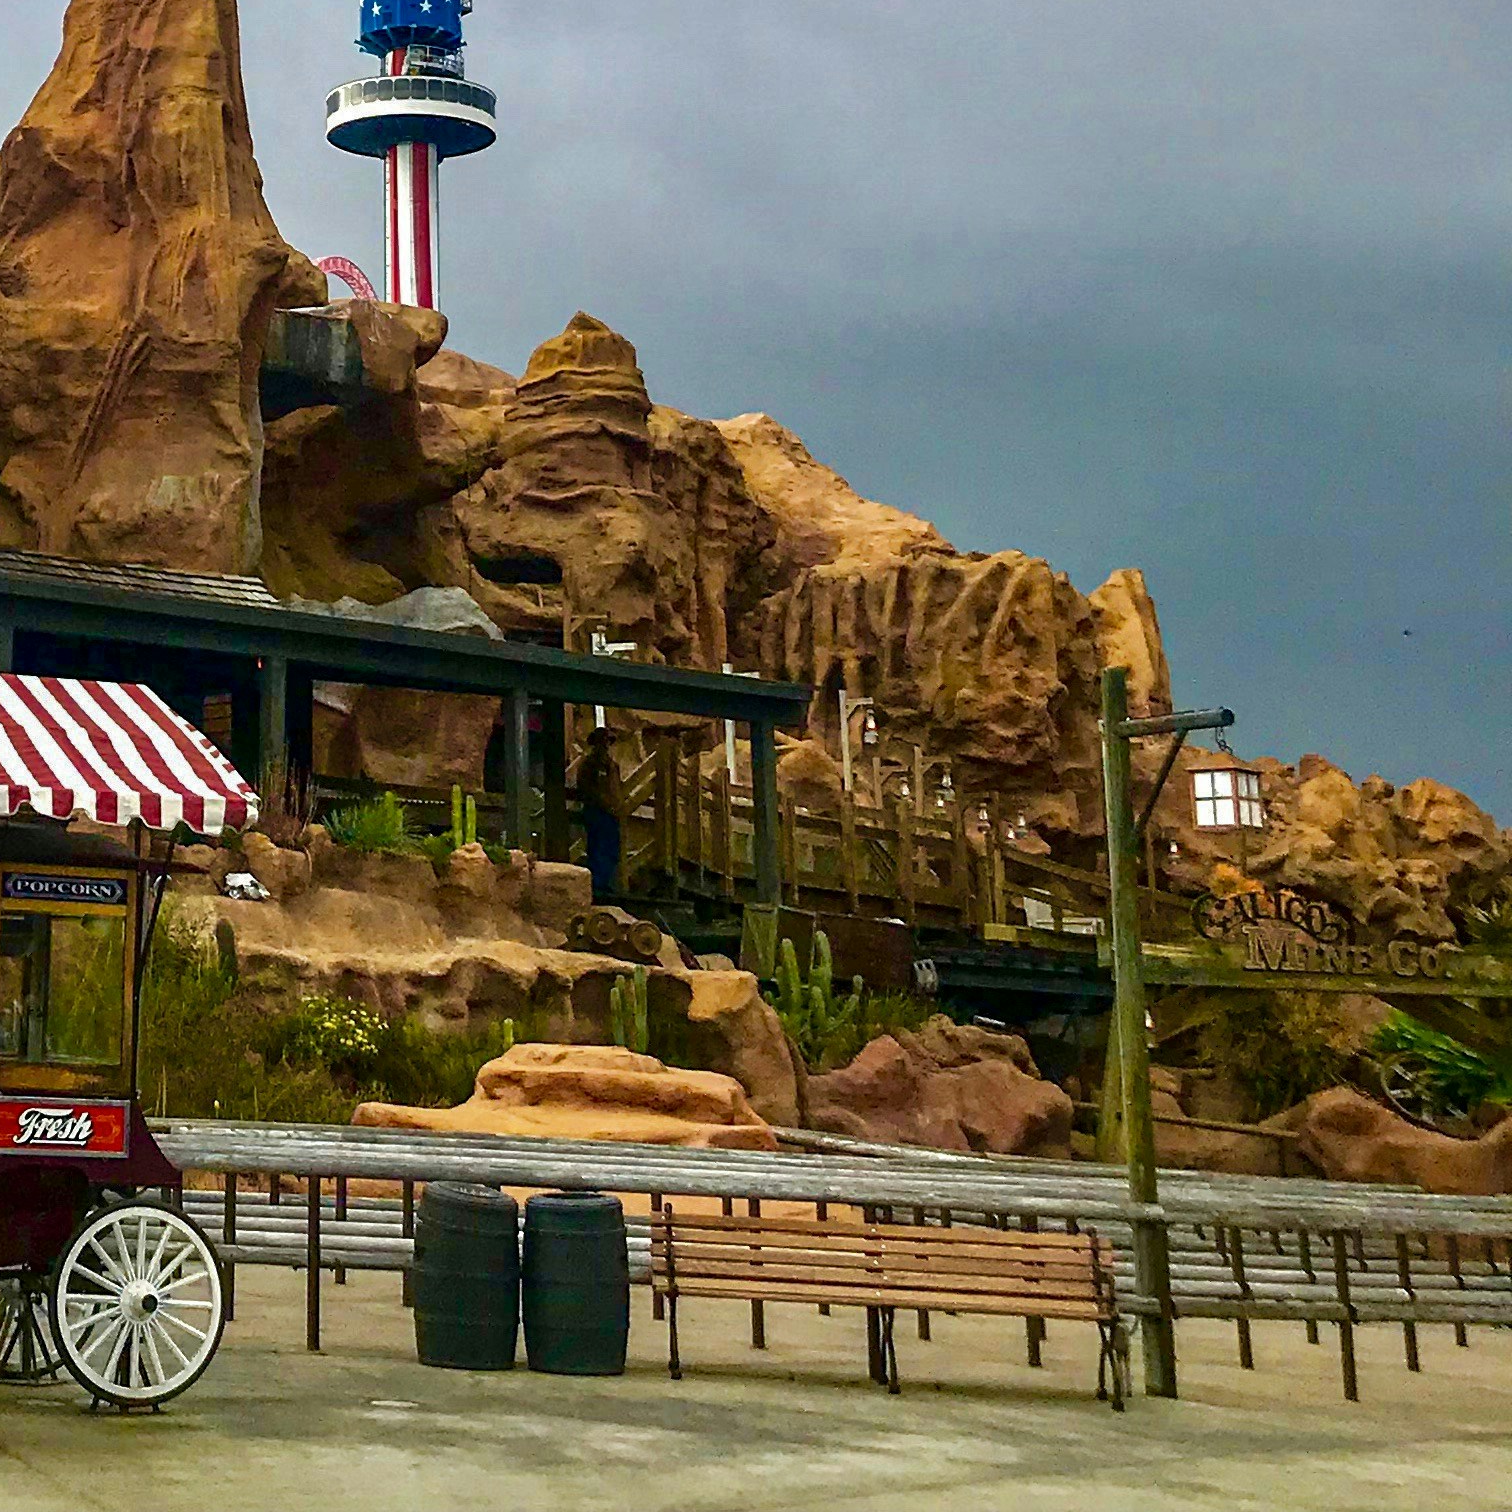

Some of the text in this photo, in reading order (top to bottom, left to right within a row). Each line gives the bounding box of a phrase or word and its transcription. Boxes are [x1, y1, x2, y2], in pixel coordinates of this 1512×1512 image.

[16, 879, 113, 899] POPCORN
[1191, 889, 1333, 941] CALICO
[1242, 924, 1378, 976] MINE
[12, 1107, 94, 1145] Fresh
